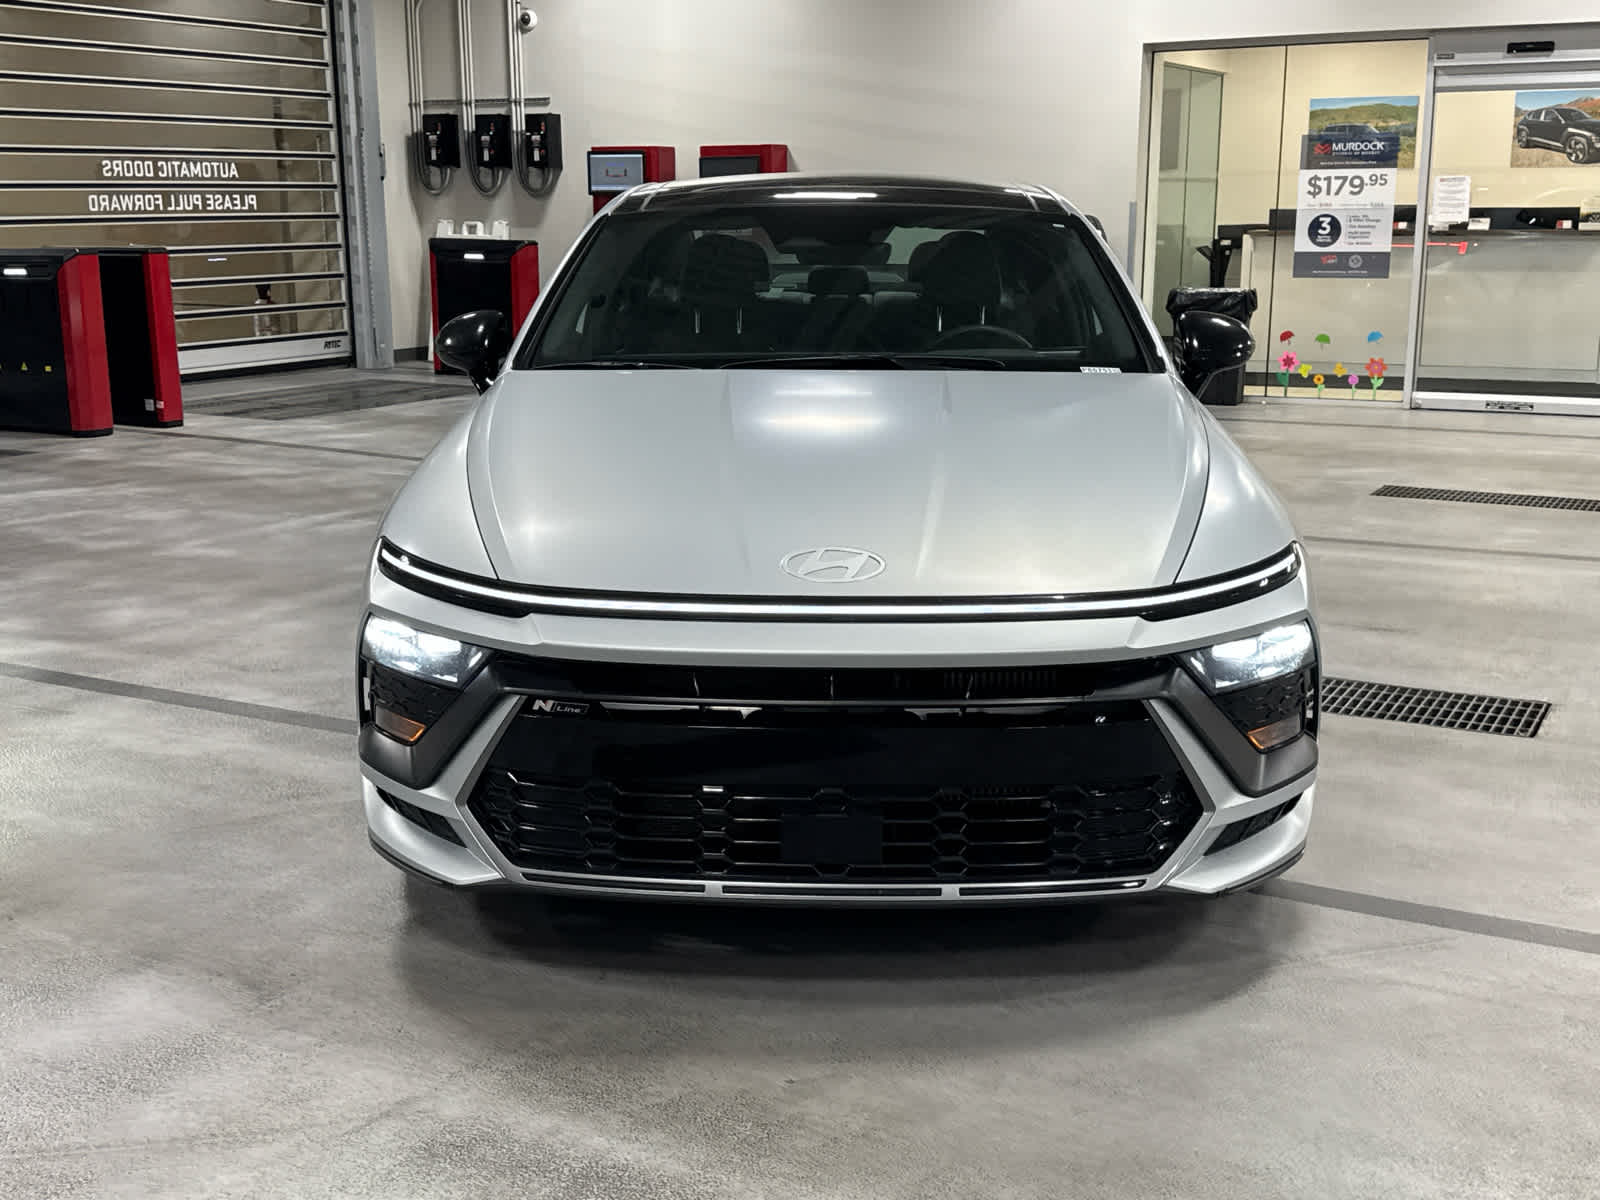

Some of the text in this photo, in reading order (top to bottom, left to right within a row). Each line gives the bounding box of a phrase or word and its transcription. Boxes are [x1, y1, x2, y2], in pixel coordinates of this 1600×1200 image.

[1332, 141, 1385, 152] MURDOCK
[1317, 216, 1332, 235] 3
[532, 699, 554, 712] N
